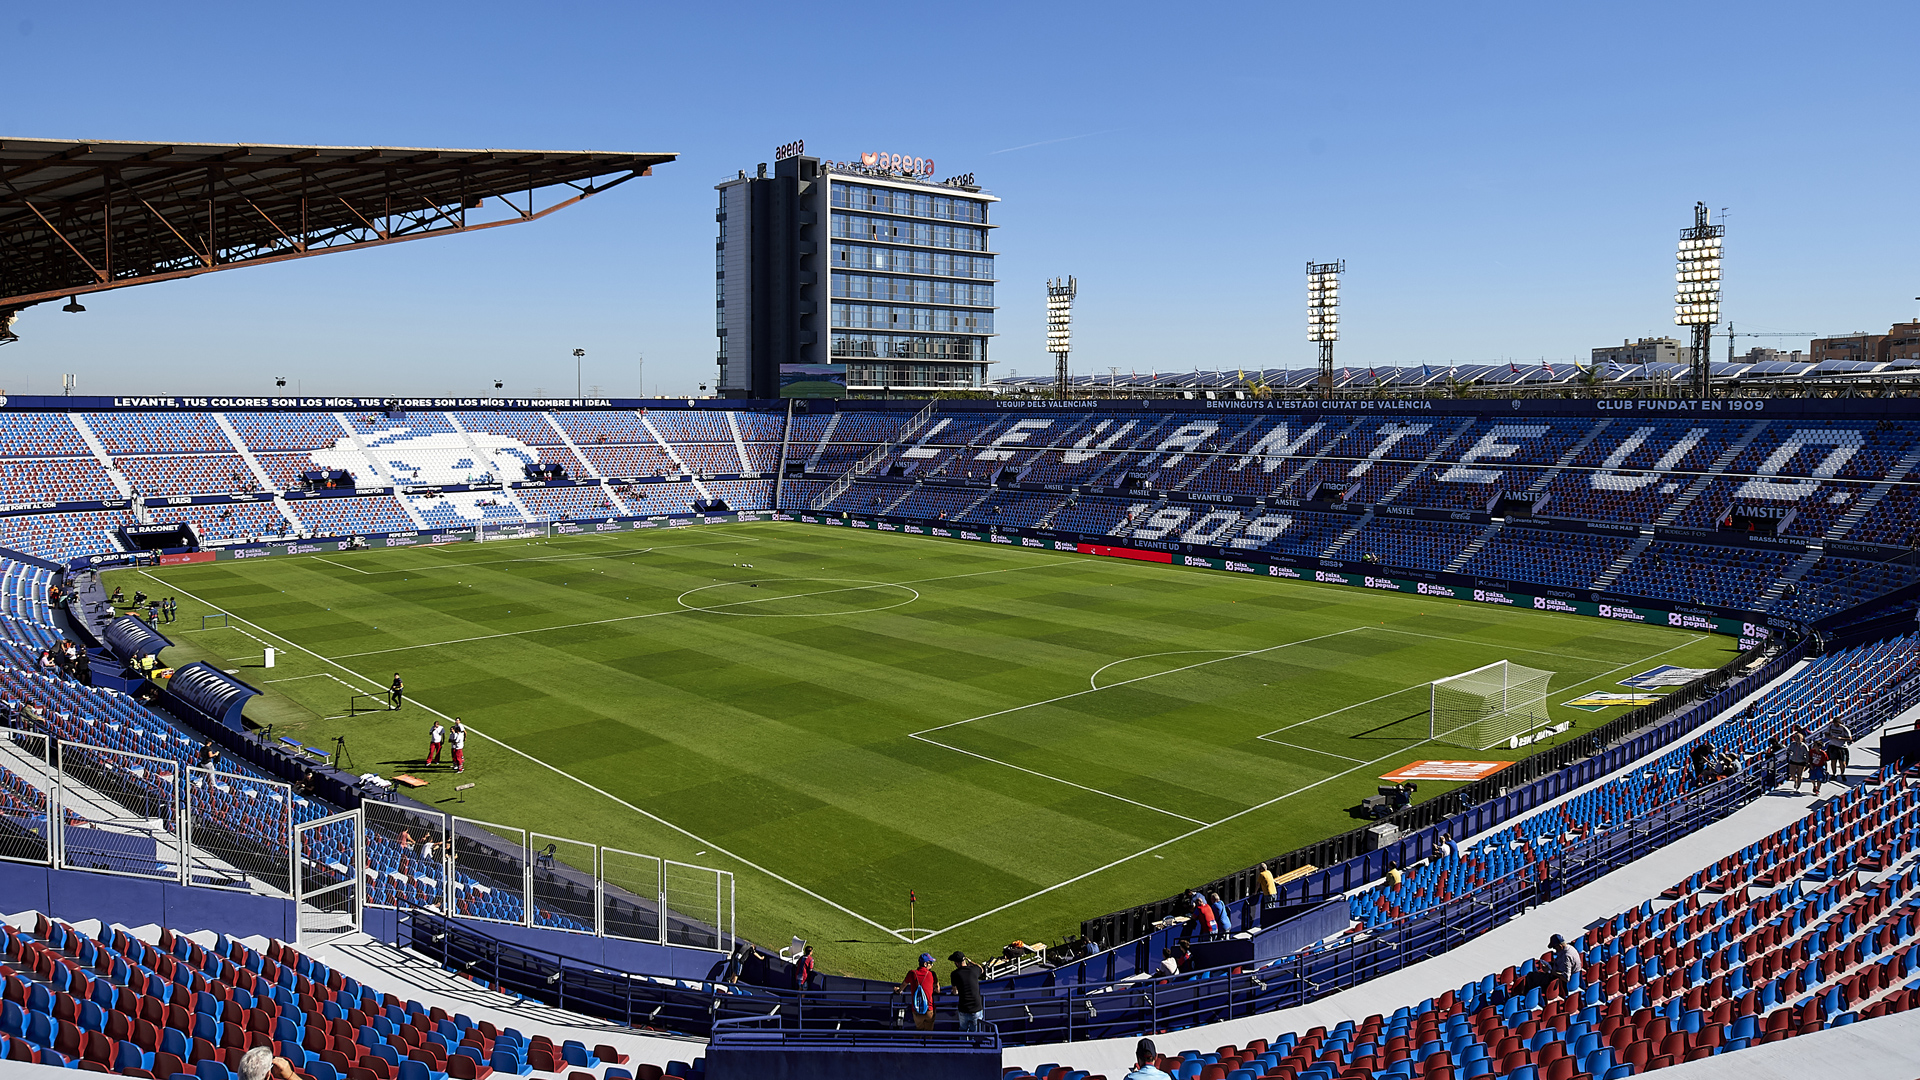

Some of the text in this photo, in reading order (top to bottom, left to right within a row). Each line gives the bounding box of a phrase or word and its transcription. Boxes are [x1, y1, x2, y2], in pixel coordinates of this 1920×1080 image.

[776, 139, 804, 160] arena
[879, 152, 934, 176] arena
[114, 398, 180, 408] LEVANTE,
[182, 398, 208, 407] TUS
[211, 398, 269, 407] COLORES
[272, 398, 297, 407] SON
[300, 399, 322, 407] LOS
[325, 398, 358, 408] MÍOS,
[360, 399, 380, 407] TUS
[434, 399, 456, 407] SON
[458, 399, 478, 407] LOS
[481, 398, 505, 407] MÍOS
[1206, 401, 1264, 409] BENVINGUTS
[1267, 401, 1274, 409] A
[1276, 401, 1318, 409] L'ESTADI
[1322, 401, 1358, 409] CIUTAT
[1361, 401, 1374, 409] DE
[1597, 400, 1764, 411] CLUB FUNDAT EN 1909
[900, 418, 1551, 484] LEVANTE
[1188, 493, 1221, 501] LEVANTE
[1386, 506, 1415, 516] AMSTEL
[139, 525, 180, 533] RACONET
[1107, 503, 1293, 550] 1909
[1134, 540, 1167, 549] LEVANTE
[1749, 535, 1778, 544] BRASSA
[1831, 543, 1878, 553] BODEGAS FOS
[1547, 590, 1575, 599] macron
[1547, 604, 1577, 613] popular
[1612, 612, 1645, 621] popular
[1683, 620, 1718, 630] popular
[1767, 617, 1790, 629] asisa
